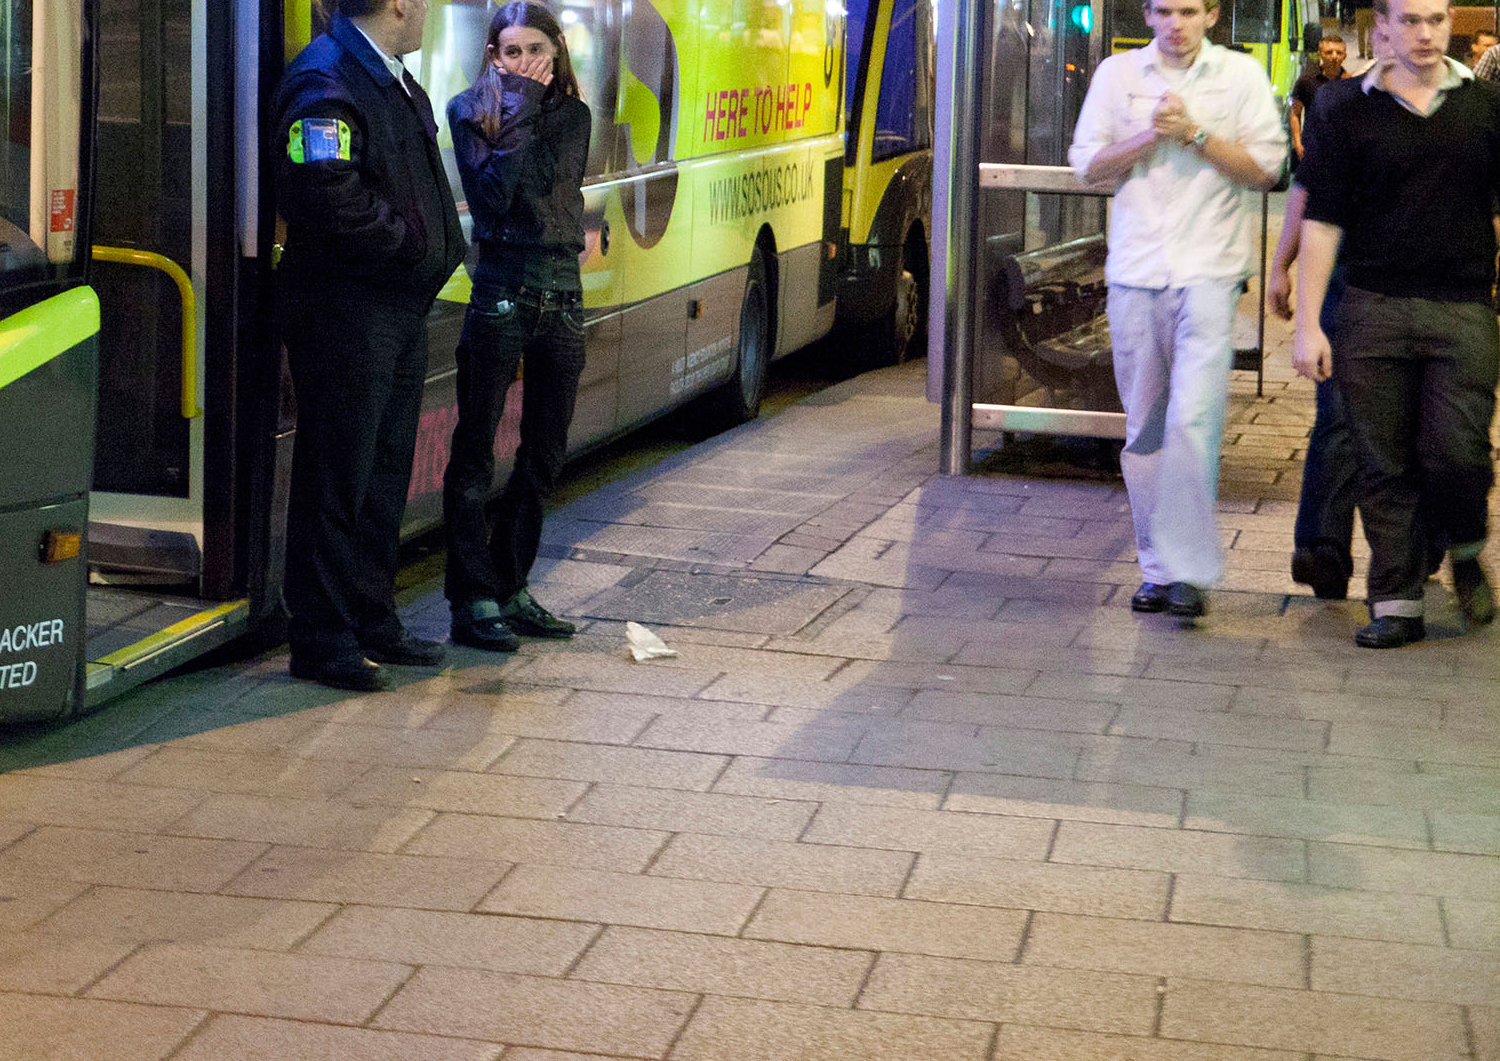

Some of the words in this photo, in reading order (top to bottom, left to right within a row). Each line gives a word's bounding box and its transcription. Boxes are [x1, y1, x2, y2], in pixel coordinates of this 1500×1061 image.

[703, 89, 750, 143] HERE
[754, 85, 773, 135] TO
[775, 82, 813, 132] HELP
